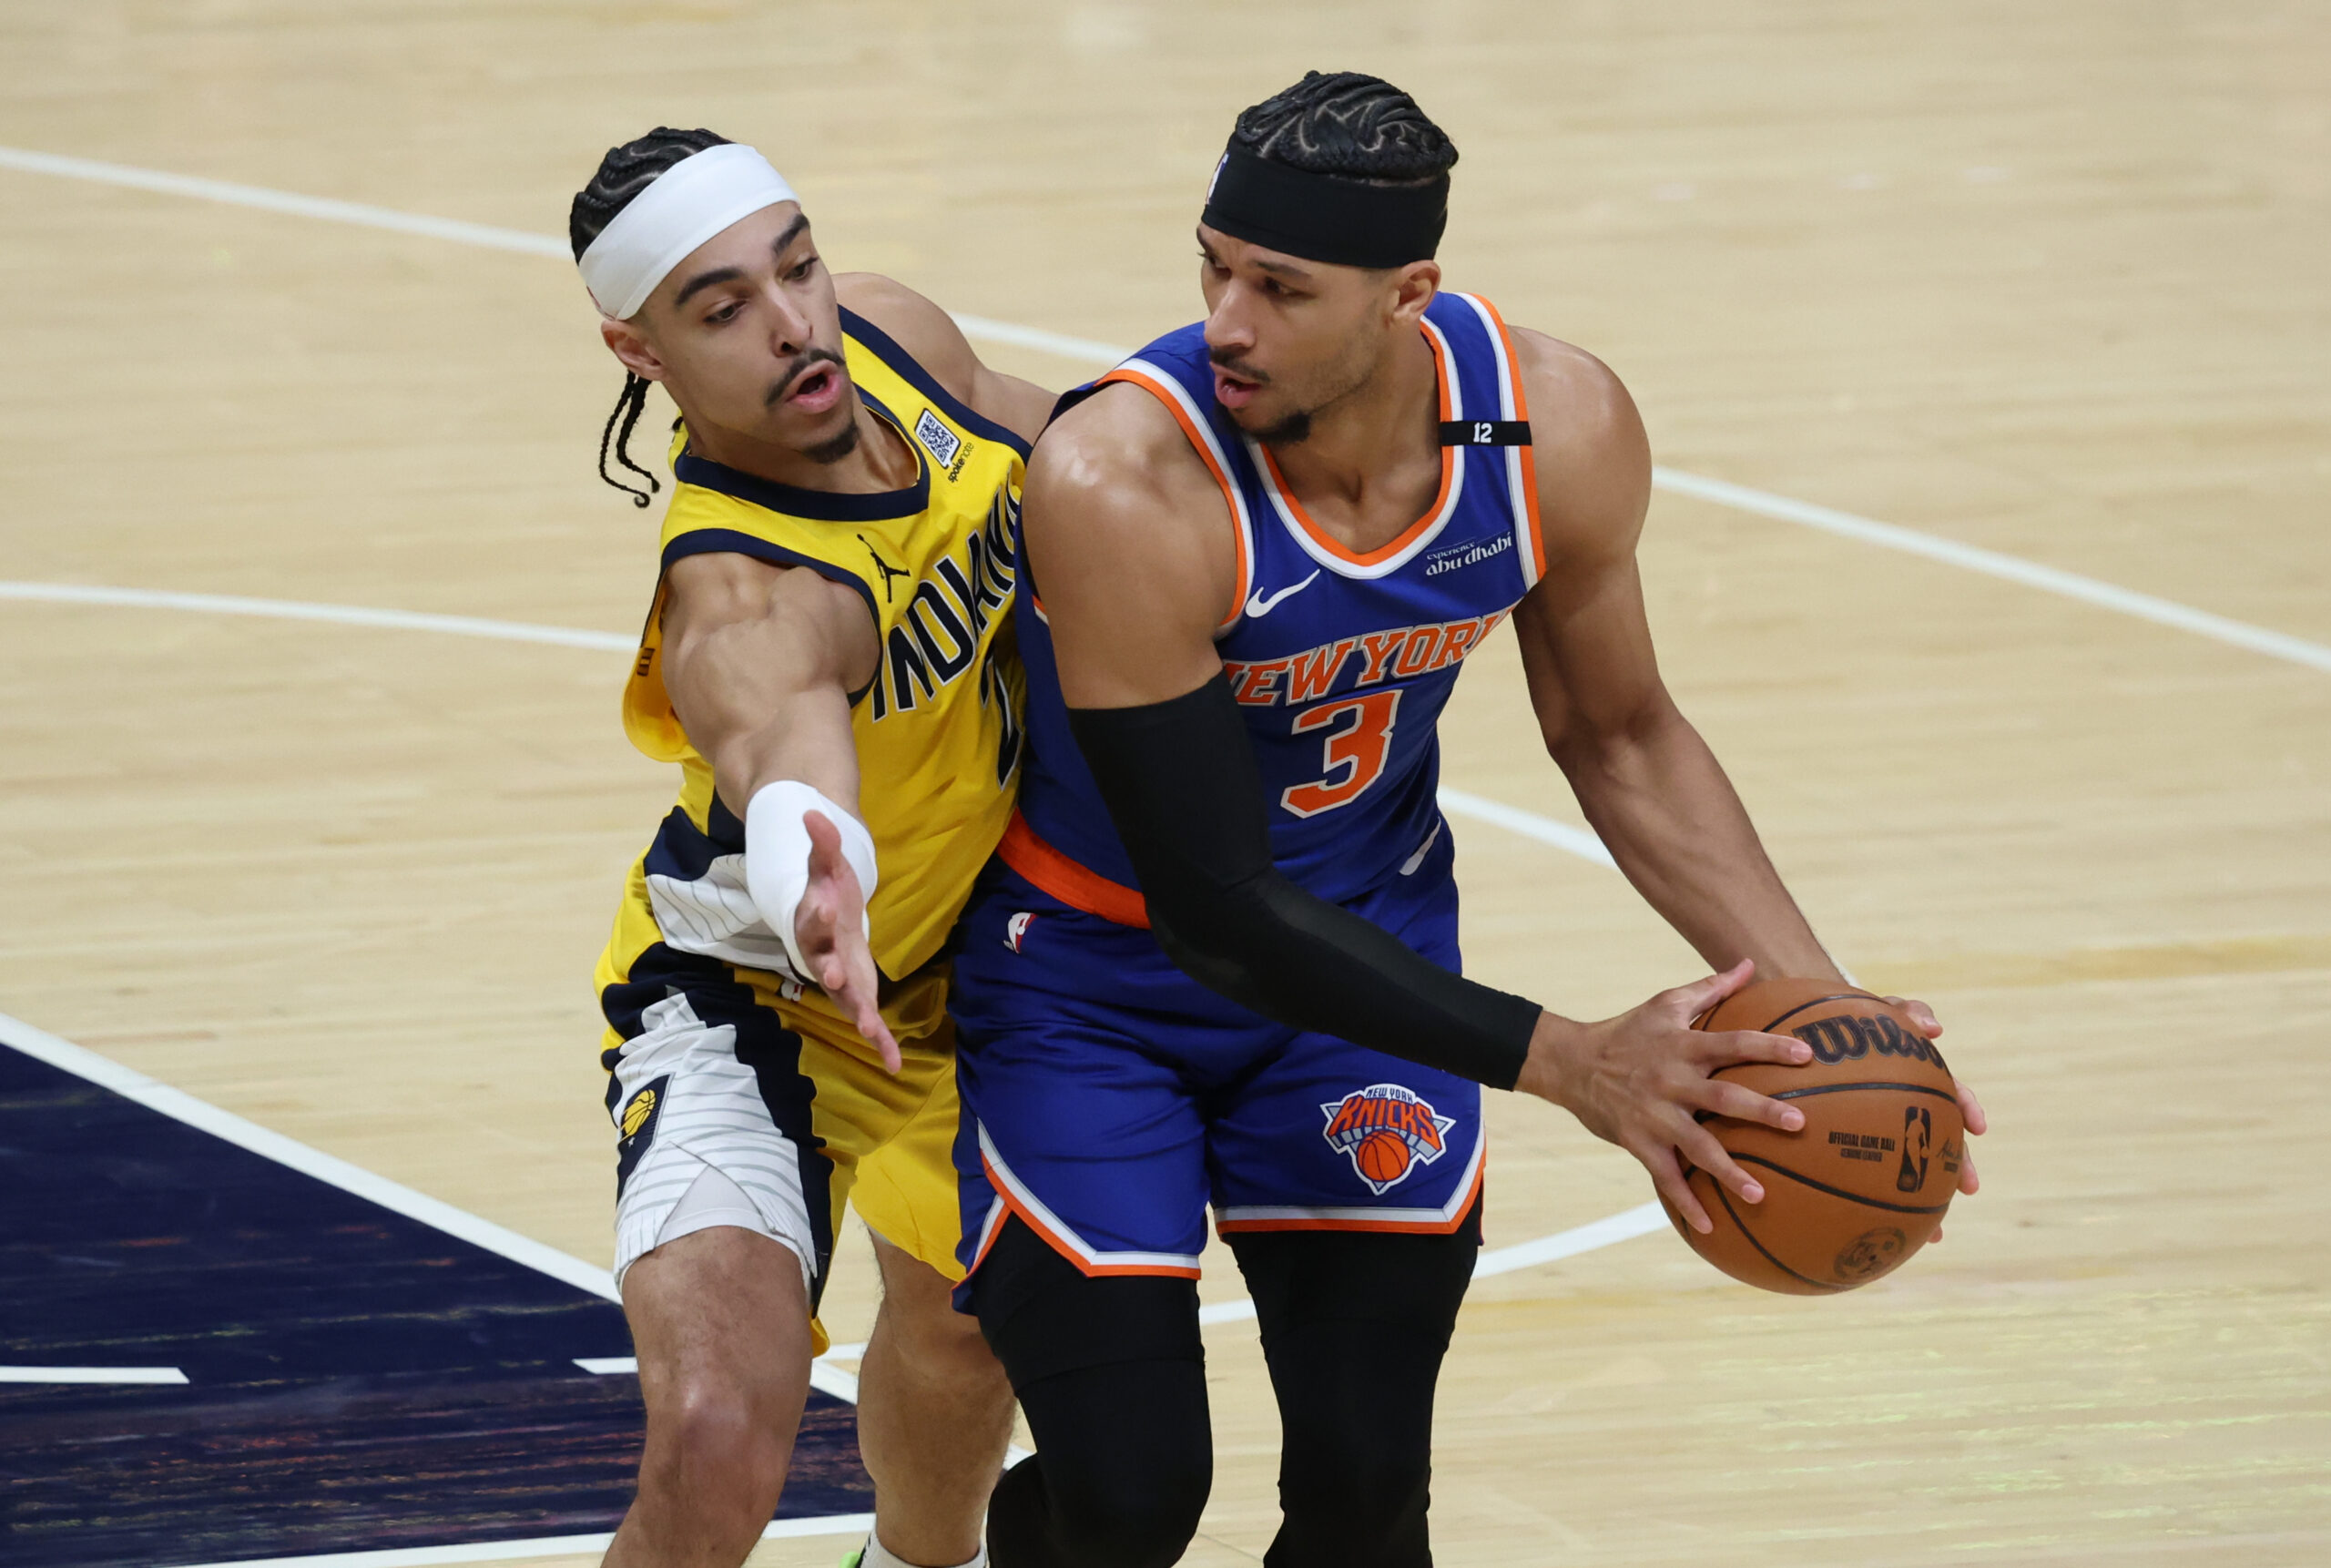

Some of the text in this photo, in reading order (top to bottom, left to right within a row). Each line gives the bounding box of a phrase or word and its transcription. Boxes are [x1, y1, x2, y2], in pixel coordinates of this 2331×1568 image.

[1473, 423, 1492, 443] 12
[1426, 531, 1512, 576] abu dhabi
[1280, 688, 1404, 819] 3
[1365, 1087, 1413, 1103] NEW YORK
[1327, 1095, 1443, 1152] KNICKS
